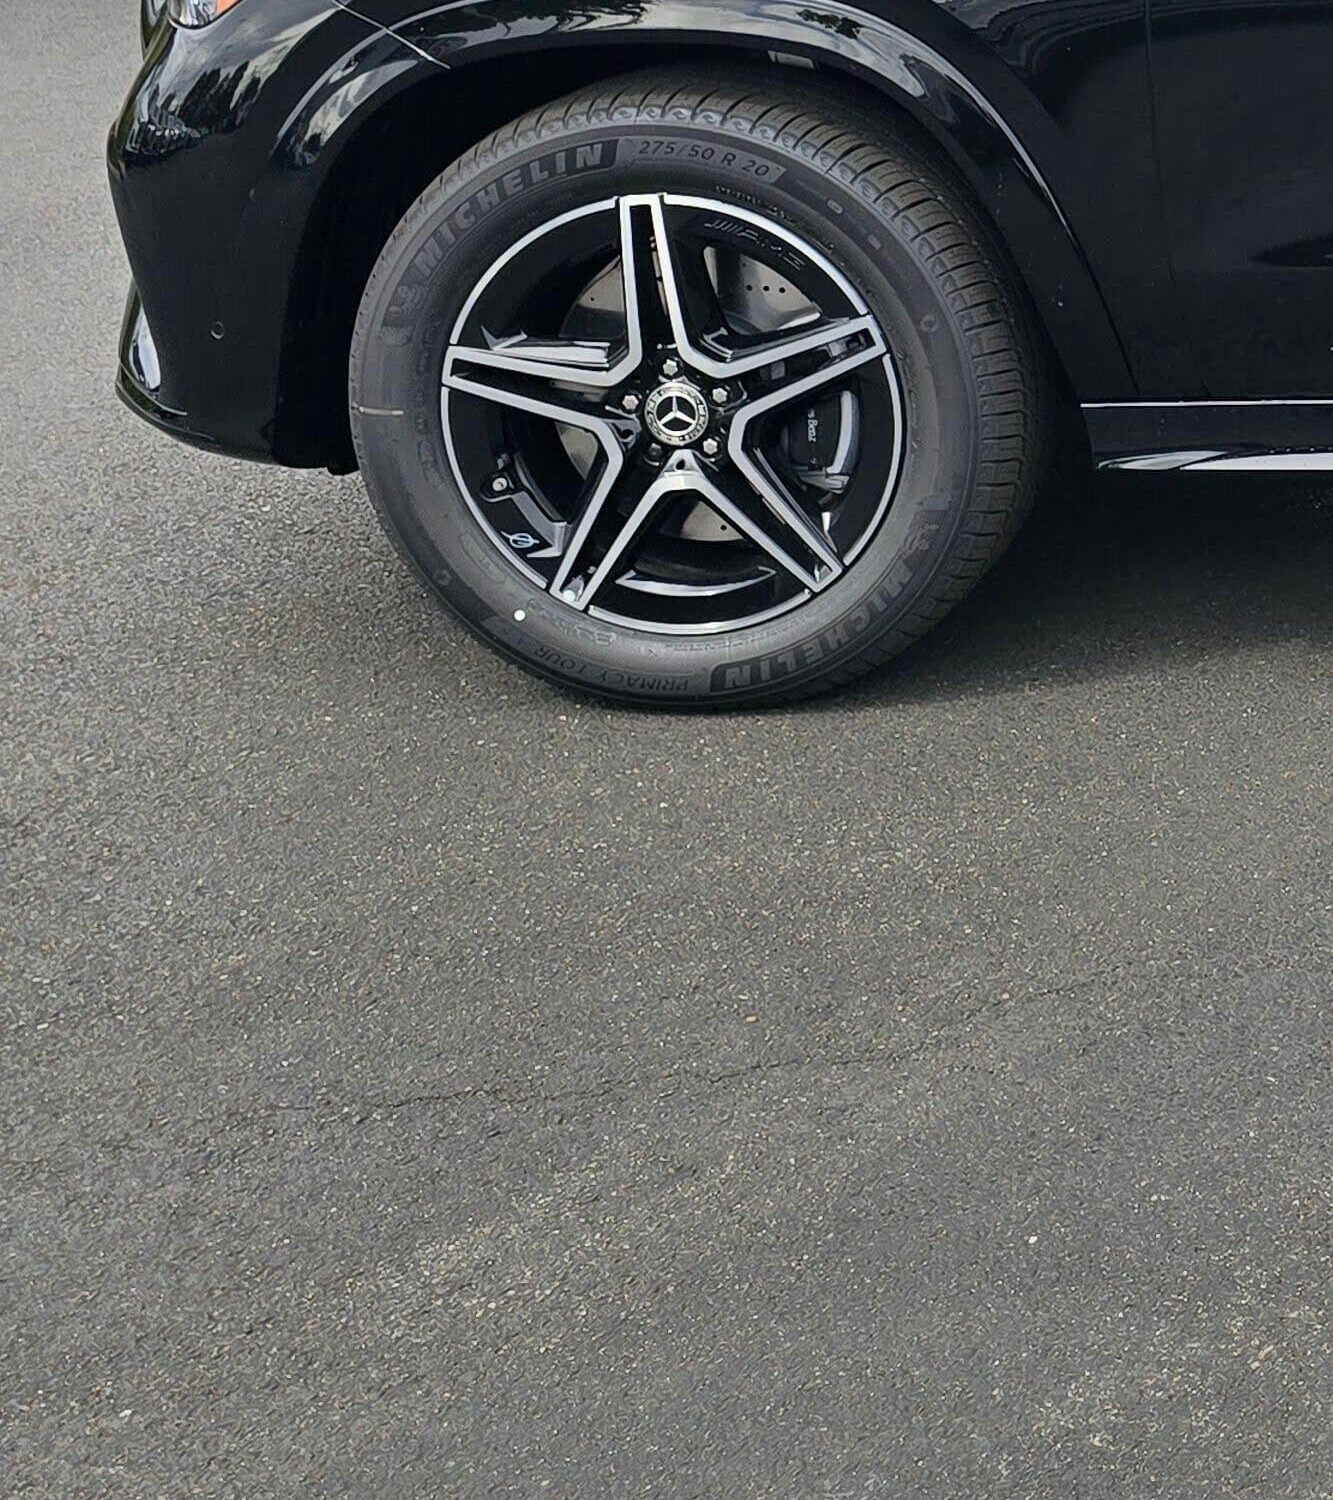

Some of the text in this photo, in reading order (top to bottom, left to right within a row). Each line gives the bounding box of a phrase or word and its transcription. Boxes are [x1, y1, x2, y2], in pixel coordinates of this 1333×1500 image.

[412, 140, 770, 279] MICHELIN 275/50 R 20
[533, 563, 916, 692] MICHELIN PRIMACY TOUR
